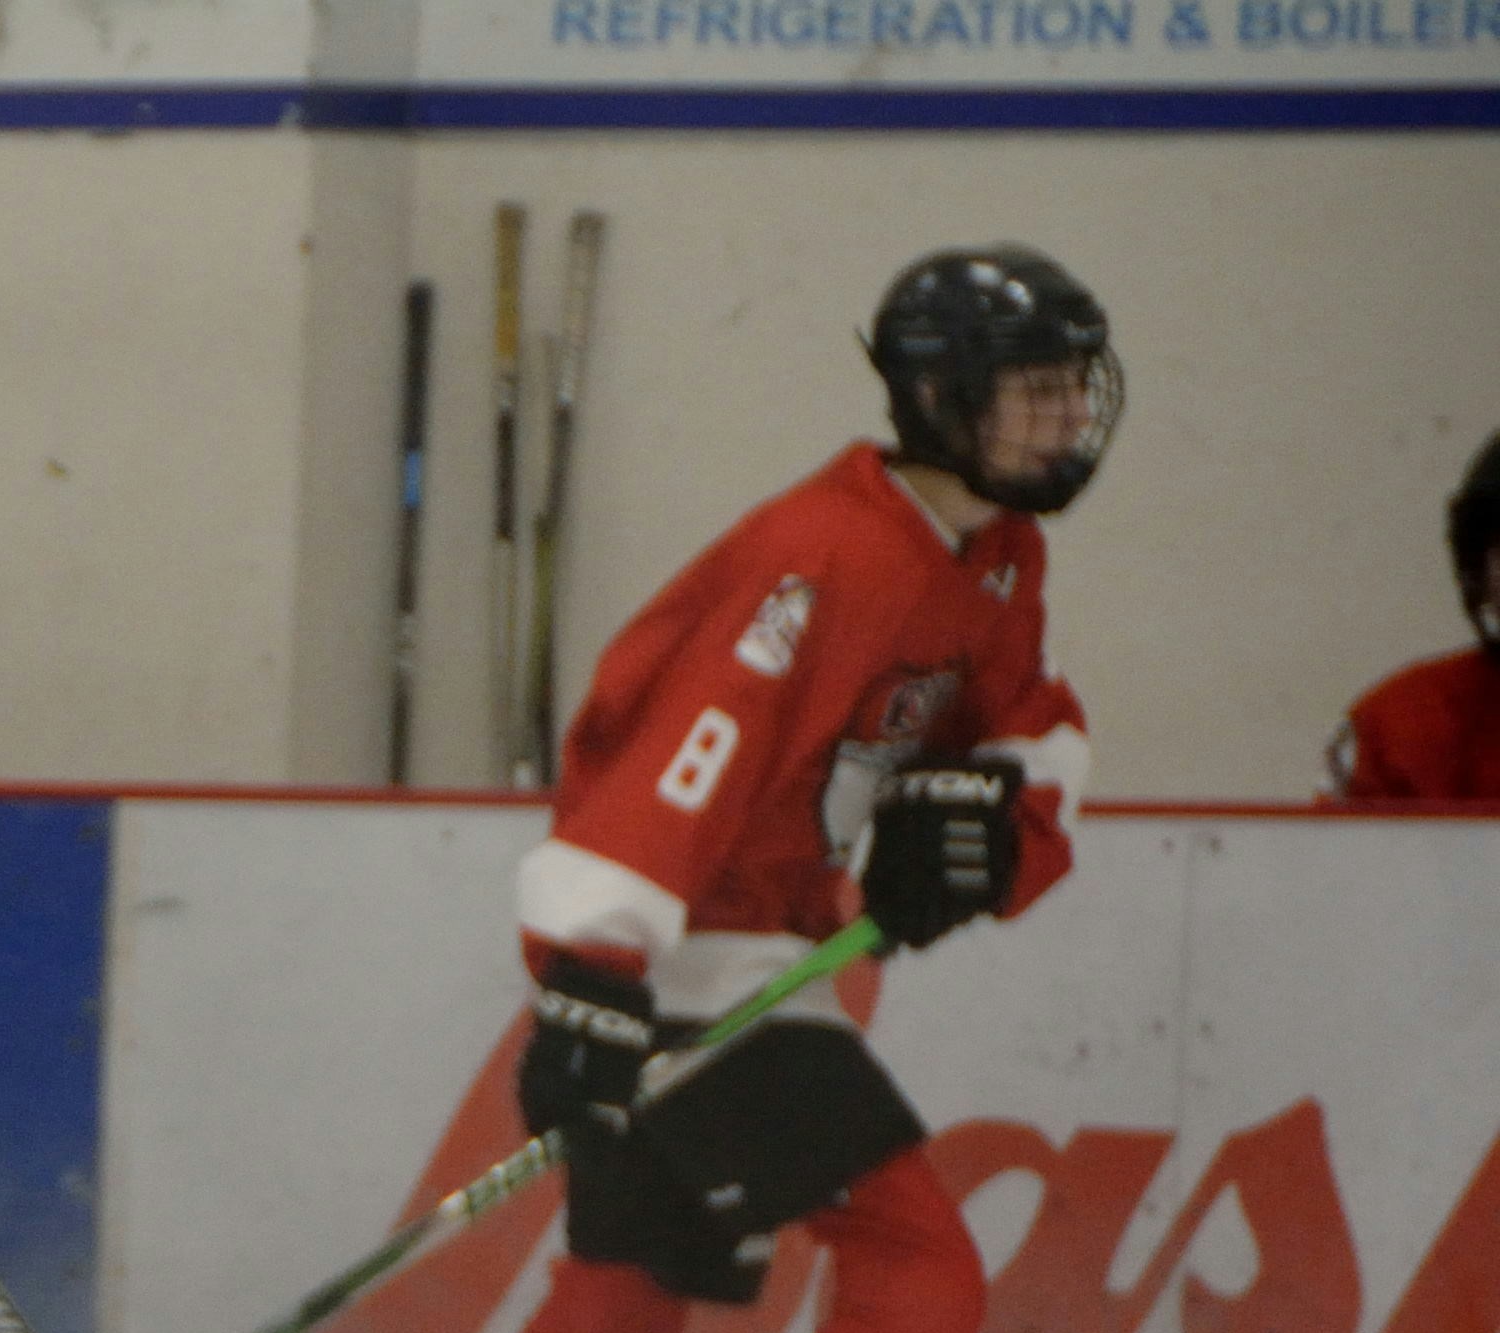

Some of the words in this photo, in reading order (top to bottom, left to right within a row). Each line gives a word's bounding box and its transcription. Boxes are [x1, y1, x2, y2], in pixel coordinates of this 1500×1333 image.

[550, 0, 1132, 48] REFRIGERATION
[1164, 0, 1211, 47] &
[657, 706, 739, 813] 8
